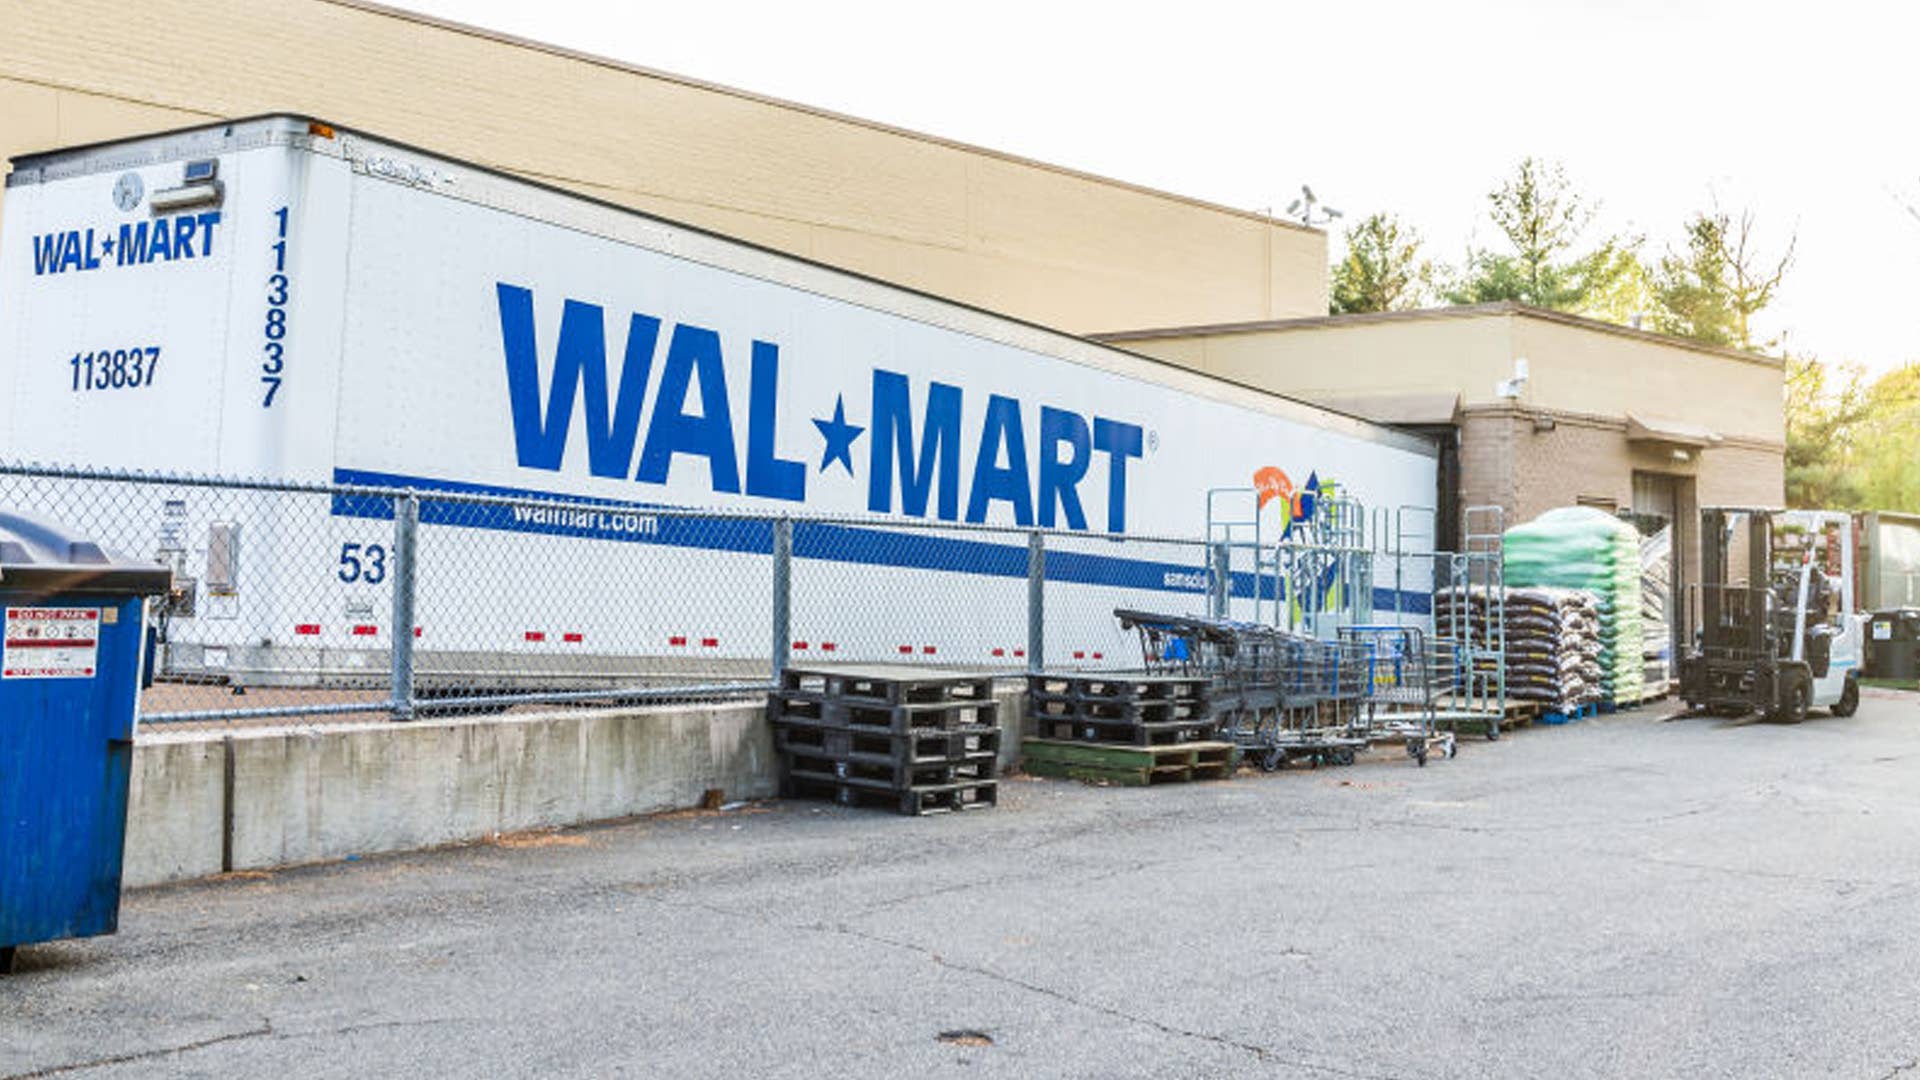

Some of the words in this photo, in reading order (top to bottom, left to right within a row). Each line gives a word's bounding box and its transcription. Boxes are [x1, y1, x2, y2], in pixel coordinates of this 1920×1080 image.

[262, 206, 289, 408] 113837
[70, 346, 161, 391] 113837
[513, 505, 659, 535] walmart.com
